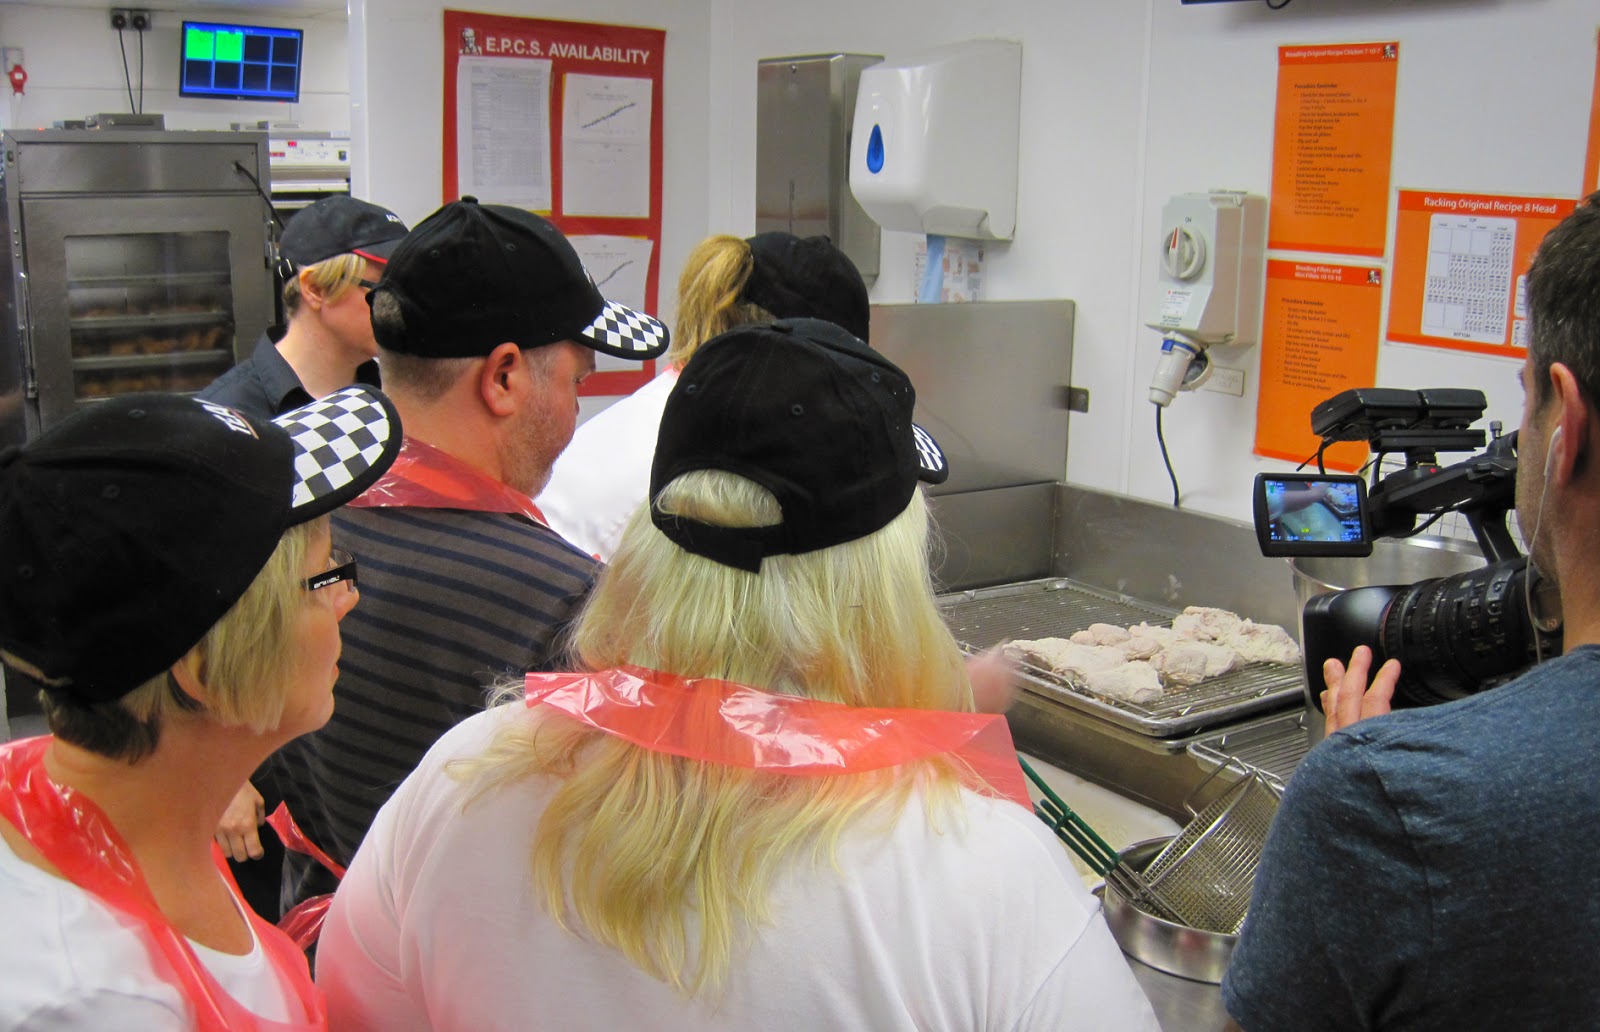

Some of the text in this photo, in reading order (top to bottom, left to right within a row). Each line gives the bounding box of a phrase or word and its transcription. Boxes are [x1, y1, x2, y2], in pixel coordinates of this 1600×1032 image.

[486, 37, 650, 64] E.P.C.S. AVAILABILITY
[1307, 50, 1326, 58] Original
[1327, 49, 1343, 57] Recipe
[1424, 197, 1557, 214] Racking Original Recipe 8 Head
